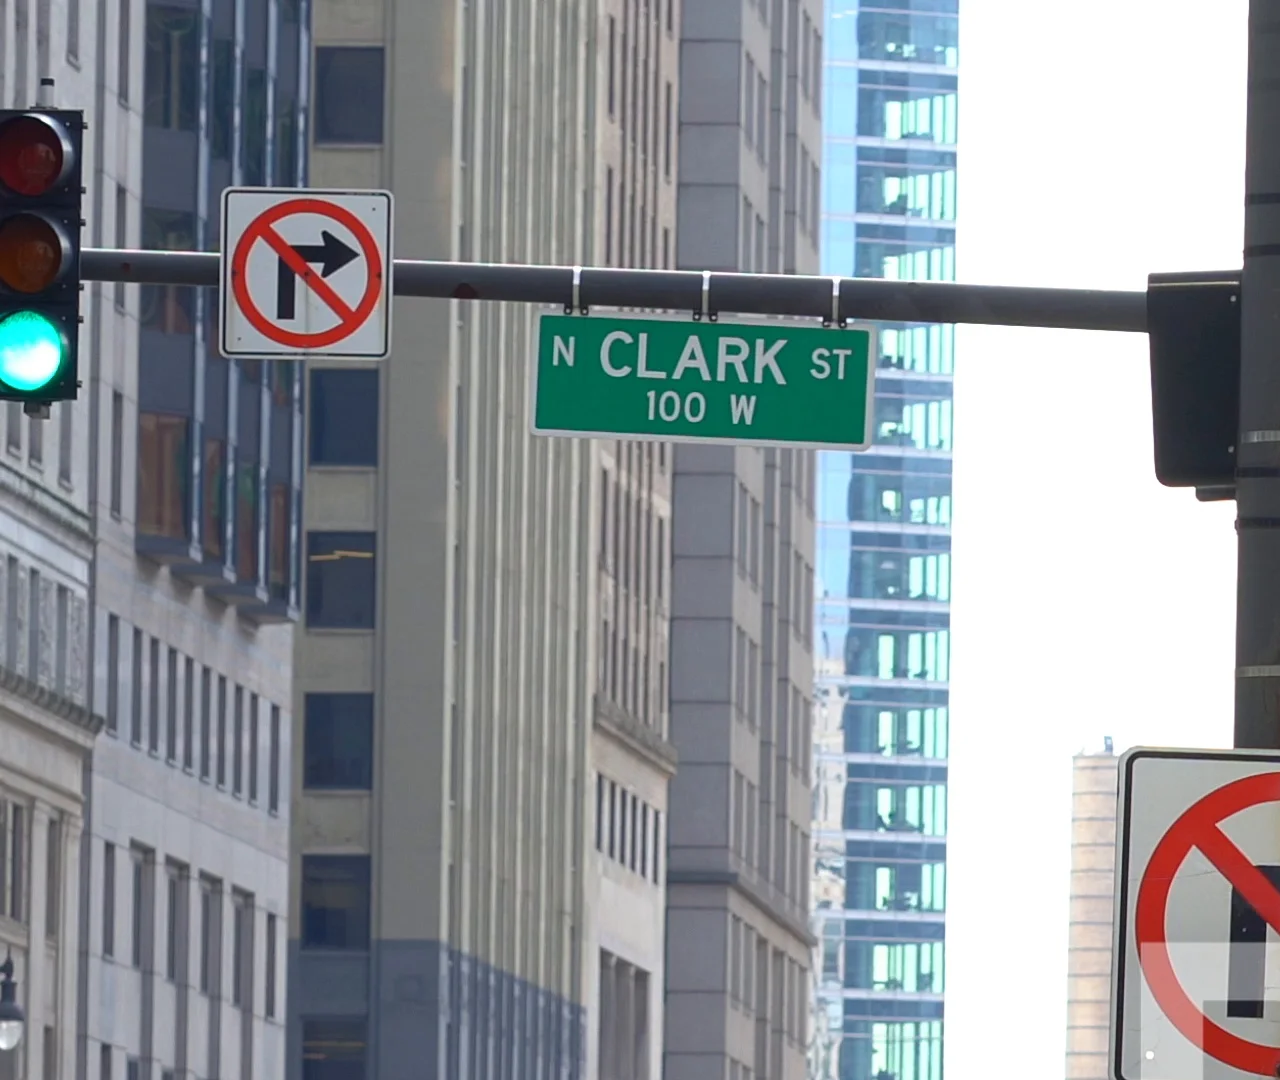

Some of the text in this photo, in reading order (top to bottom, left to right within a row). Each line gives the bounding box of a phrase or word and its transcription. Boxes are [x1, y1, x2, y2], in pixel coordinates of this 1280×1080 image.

[552, 330, 852, 385] N CLARK ST
[646, 390, 756, 425] 100 W
